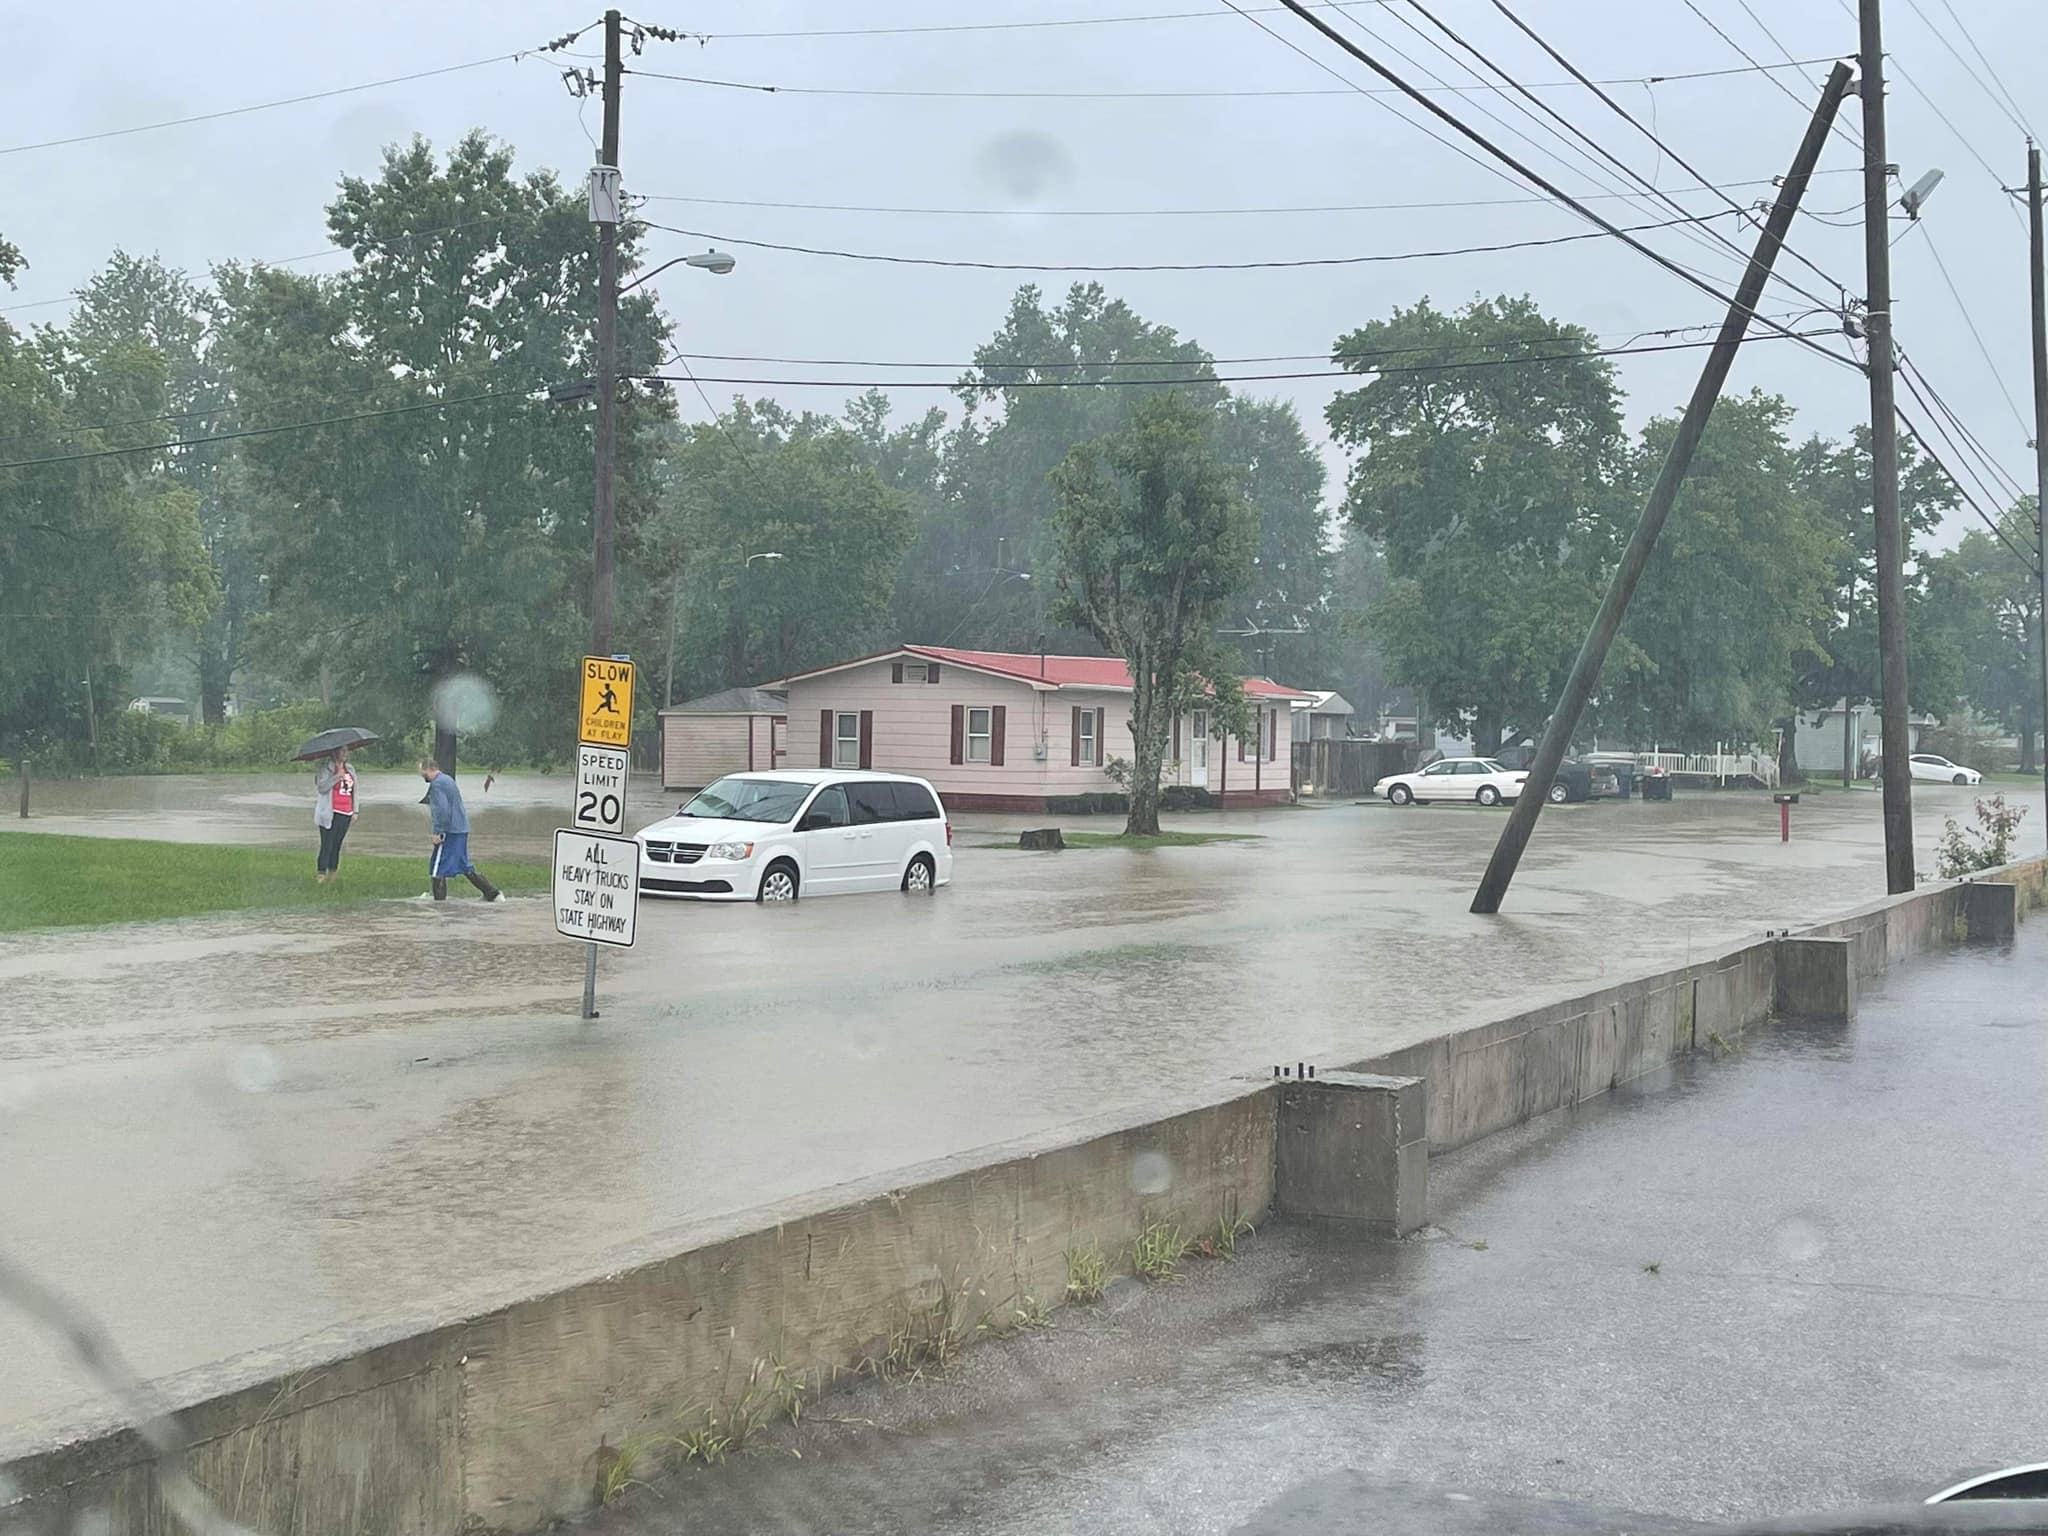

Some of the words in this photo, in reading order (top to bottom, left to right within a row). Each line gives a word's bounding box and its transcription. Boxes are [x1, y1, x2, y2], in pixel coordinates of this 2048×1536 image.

[588, 663, 630, 682] SLOW
[585, 717, 626, 730] CHILDREN
[587, 729, 597, 737] AT
[601, 730, 623, 740] PLAY
[582, 754, 624, 770] SPEED
[584, 772, 619, 788] LIMIT
[578, 791, 620, 825] 20
[585, 847, 608, 865] ALL
[562, 865, 592, 884] HEAVY
[596, 870, 629, 890] TRUCKS
[574, 888, 596, 906] STAY
[600, 893, 614, 910] ON
[560, 908, 584, 927] STATE
[587, 912, 627, 934] HIGHWAY
